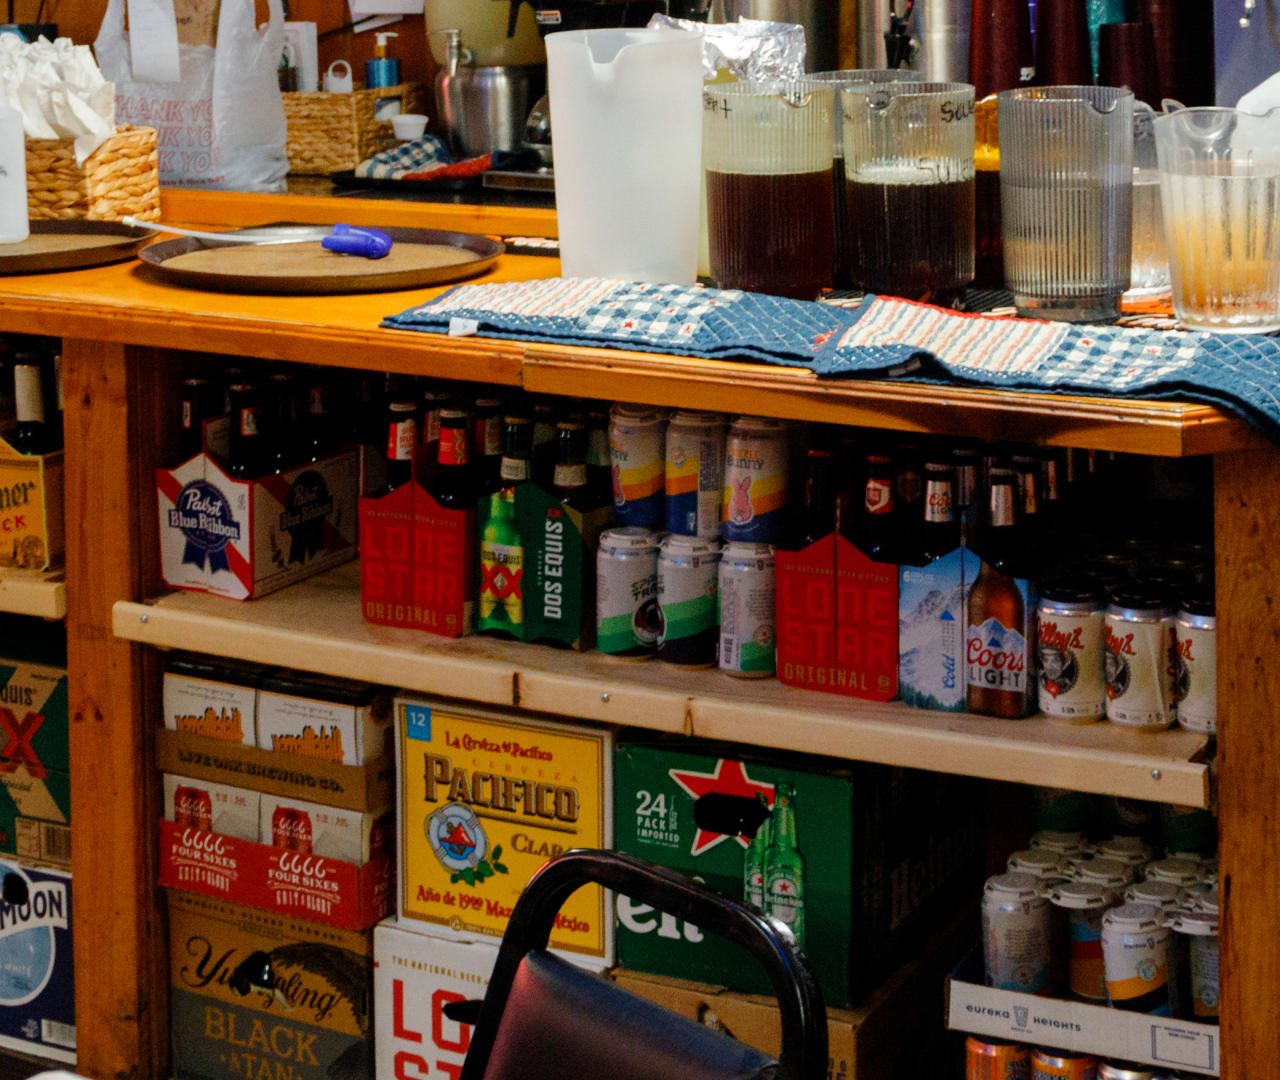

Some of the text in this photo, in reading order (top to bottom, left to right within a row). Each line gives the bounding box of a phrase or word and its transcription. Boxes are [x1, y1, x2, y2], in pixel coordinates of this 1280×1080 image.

[114, 95, 185, 123] THANK
[184, 488, 222, 517] Pabst
[169, 510, 239, 540] Blue Ribbon
[365, 523, 458, 569] LONE
[544, 518, 563, 619] DOS EQUIS
[365, 565, 458, 610] STAR
[782, 578, 890, 625] LONE
[366, 601, 438, 627] ORIGINAL
[782, 621, 890, 667] STAR
[966, 636, 1024, 672] Coors
[784, 662, 869, 691] ORIGINAL
[942, 653, 956, 690] Cold
[969, 667, 1021, 688] LIGHT
[409, 710, 426, 728] 12
[445, 731, 460, 749] La
[462, 733, 502, 754] Cerveza
[472, 758, 579, 784] CERVEZA
[423, 752, 581, 824] PACIFICO
[635, 789, 667, 818] 24
[636, 827, 680, 843] IMPORTED
[637, 815, 667, 831] PACK
[172, 843, 237, 869] FOUR SIXES
[182, 828, 226, 855] 6666
[510, 831, 571, 857] CLAR
[279, 851, 326, 879] 6666
[268, 869, 340, 892] FOUR SIXES
[416, 884, 442, 904] Año
[443, 892, 456, 907] de
[458, 893, 484, 912] 1900
[392, 954, 482, 984] THE NATIONAL BEER
[392, 978, 470, 1055] LO
[204, 1005, 320, 1067] BLACK
